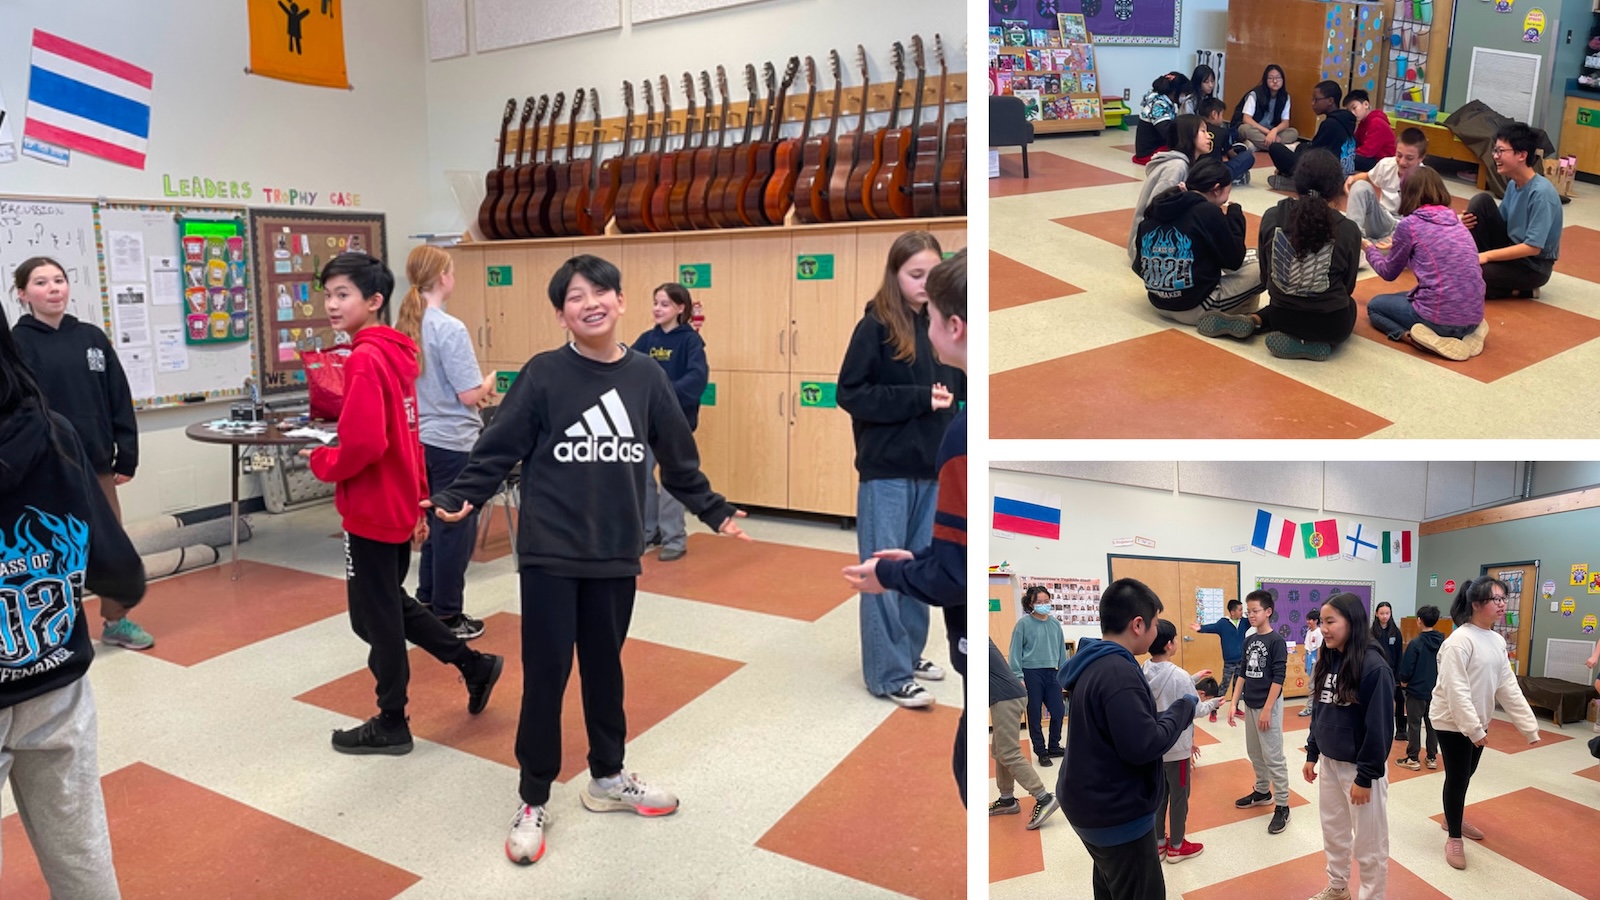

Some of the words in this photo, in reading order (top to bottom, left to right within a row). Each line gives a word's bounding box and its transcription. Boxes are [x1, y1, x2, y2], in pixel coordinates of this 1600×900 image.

[163, 174, 252, 199] LEADERS
[263, 188, 317, 206] TROPHY
[330, 192, 361, 206] CASE
[265, 372, 286, 384] WE
[553, 434, 645, 463] adidas
[31, 553, 51, 570] OF
